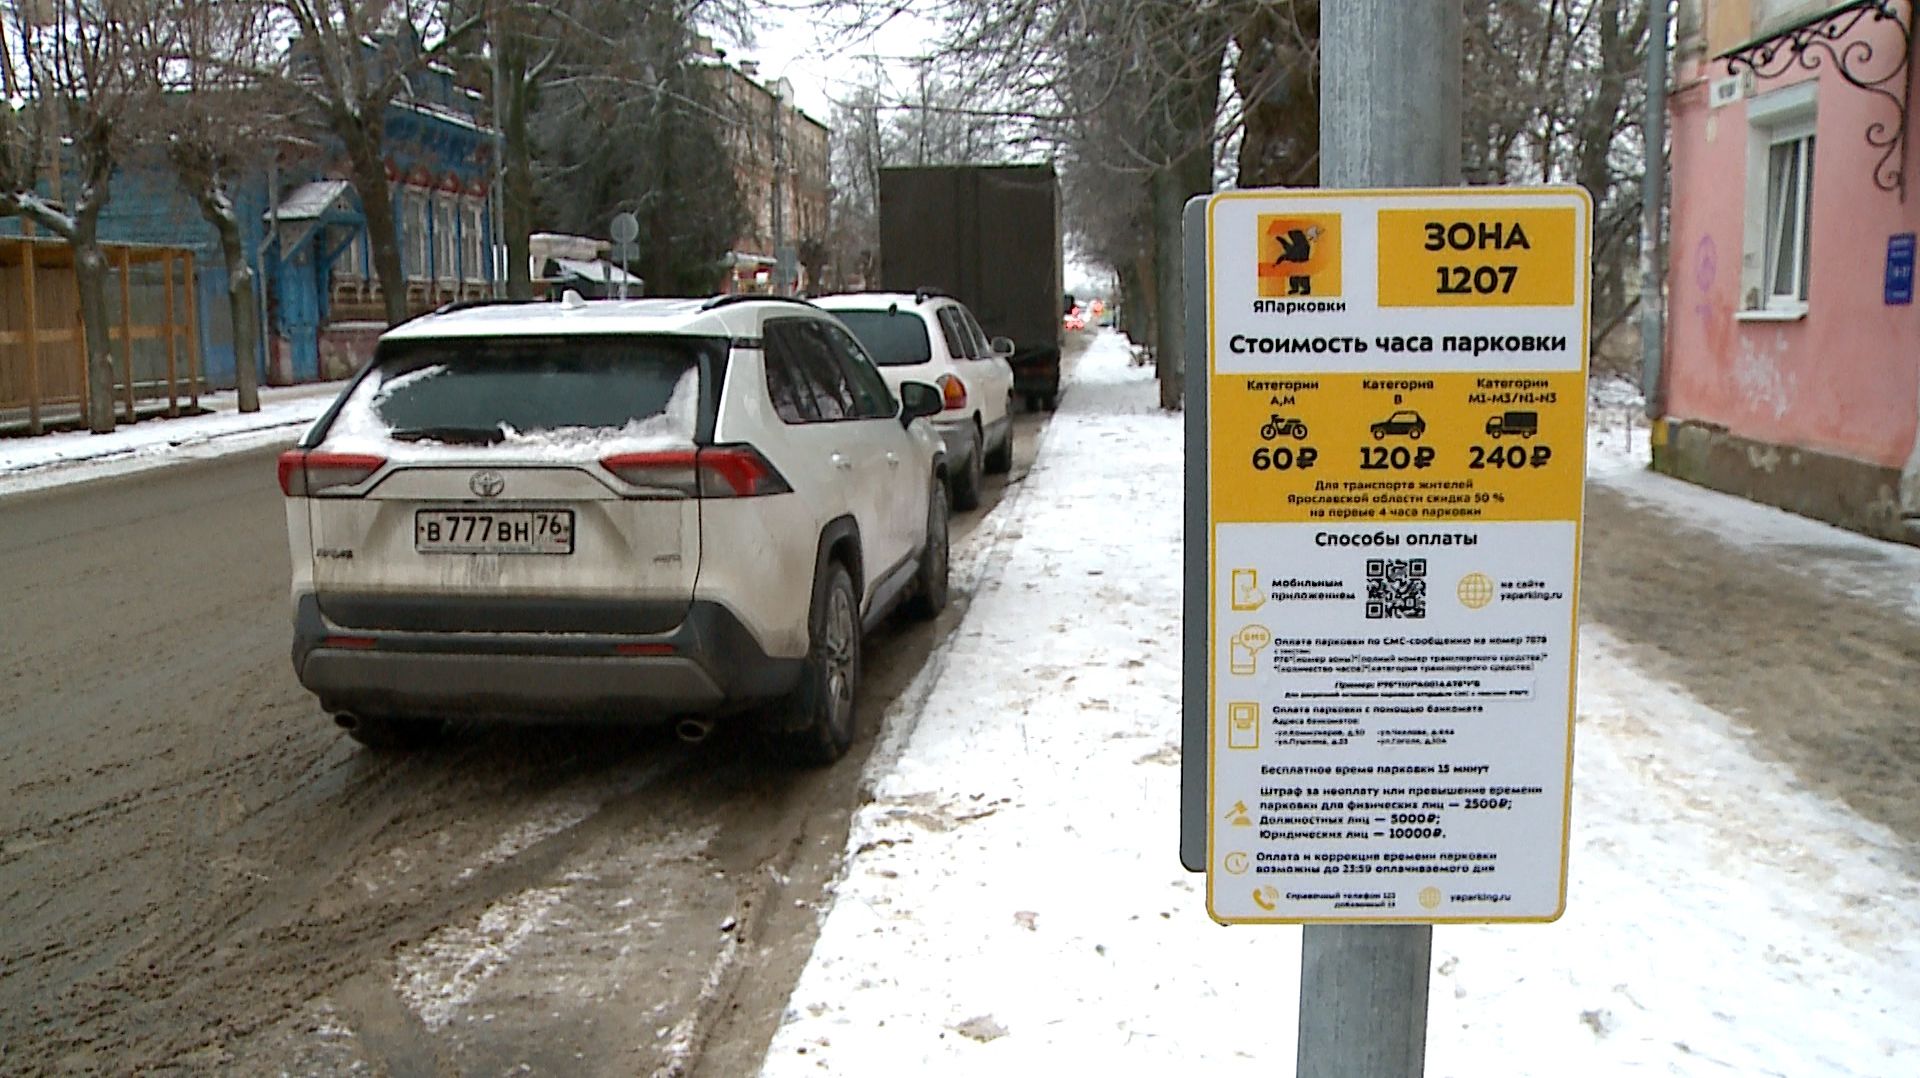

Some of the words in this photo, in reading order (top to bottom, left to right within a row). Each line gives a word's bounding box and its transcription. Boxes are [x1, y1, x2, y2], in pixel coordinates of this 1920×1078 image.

[1425, 222, 1530, 251] ЗОНА
[1437, 266, 1518, 294] 1207
[1254, 300, 1345, 315] ЯПарковки
[1230, 335, 1367, 353] Стоимость
[1376, 336, 1433, 352] часа
[1443, 336, 1565, 357] парковки
[1248, 381, 1318, 392] Категории
[1477, 378, 1548, 390] Категории
[1315, 481, 1339, 491] Для
[1343, 482, 1414, 492] транспорта
[1419, 480, 1473, 489] жителей
[1288, 492, 1368, 506] Ярославской
[1373, 492, 1423, 503] области
[1427, 495, 1470, 503] скидка
[1475, 493, 1489, 503] 50
[1310, 509, 1324, 517] на
[1329, 509, 1375, 518] первые
[1379, 508, 1386, 516] 4
[1390, 509, 1418, 517] часа
[1422, 508, 1481, 518] парковки
[536, 514, 562, 535] 76
[1315, 531, 1399, 546] Способы
[1406, 534, 1477, 545] оплаты
[1272, 579, 1343, 587] мобильным
[1272, 592, 1355, 601] приложением
[1501, 588, 1562, 600] yaparking.ru
[1275, 638, 1312, 646] Оплата
[1261, 766, 1331, 774] Бесплатное
[1336, 767, 1373, 776] время
[1377, 766, 1434, 774] парковки
[1438, 764, 1449, 773] 15
[1454, 766, 1489, 774] минут
[1261, 787, 1302, 797] Штраф
[1323, 788, 1379, 796] неоплату
[1409, 788, 1486, 796] превышение
[1490, 787, 1542, 796] времени
[1260, 802, 1317, 812] парковки
[1321, 802, 1343, 810] для
[1347, 801, 1417, 811] физических
[1422, 802, 1444, 810] лиц
[1260, 816, 1343, 825] Должностных
[1260, 830, 1342, 840] Юридических
[1257, 852, 1299, 861] Оплата
[1315, 854, 1380, 865] коррекция
[1384, 854, 1436, 862] времени
[1440, 853, 1496, 862] парковки
[1324, 866, 1339, 874] до
[1450, 894, 1511, 902] yaparking.ru
